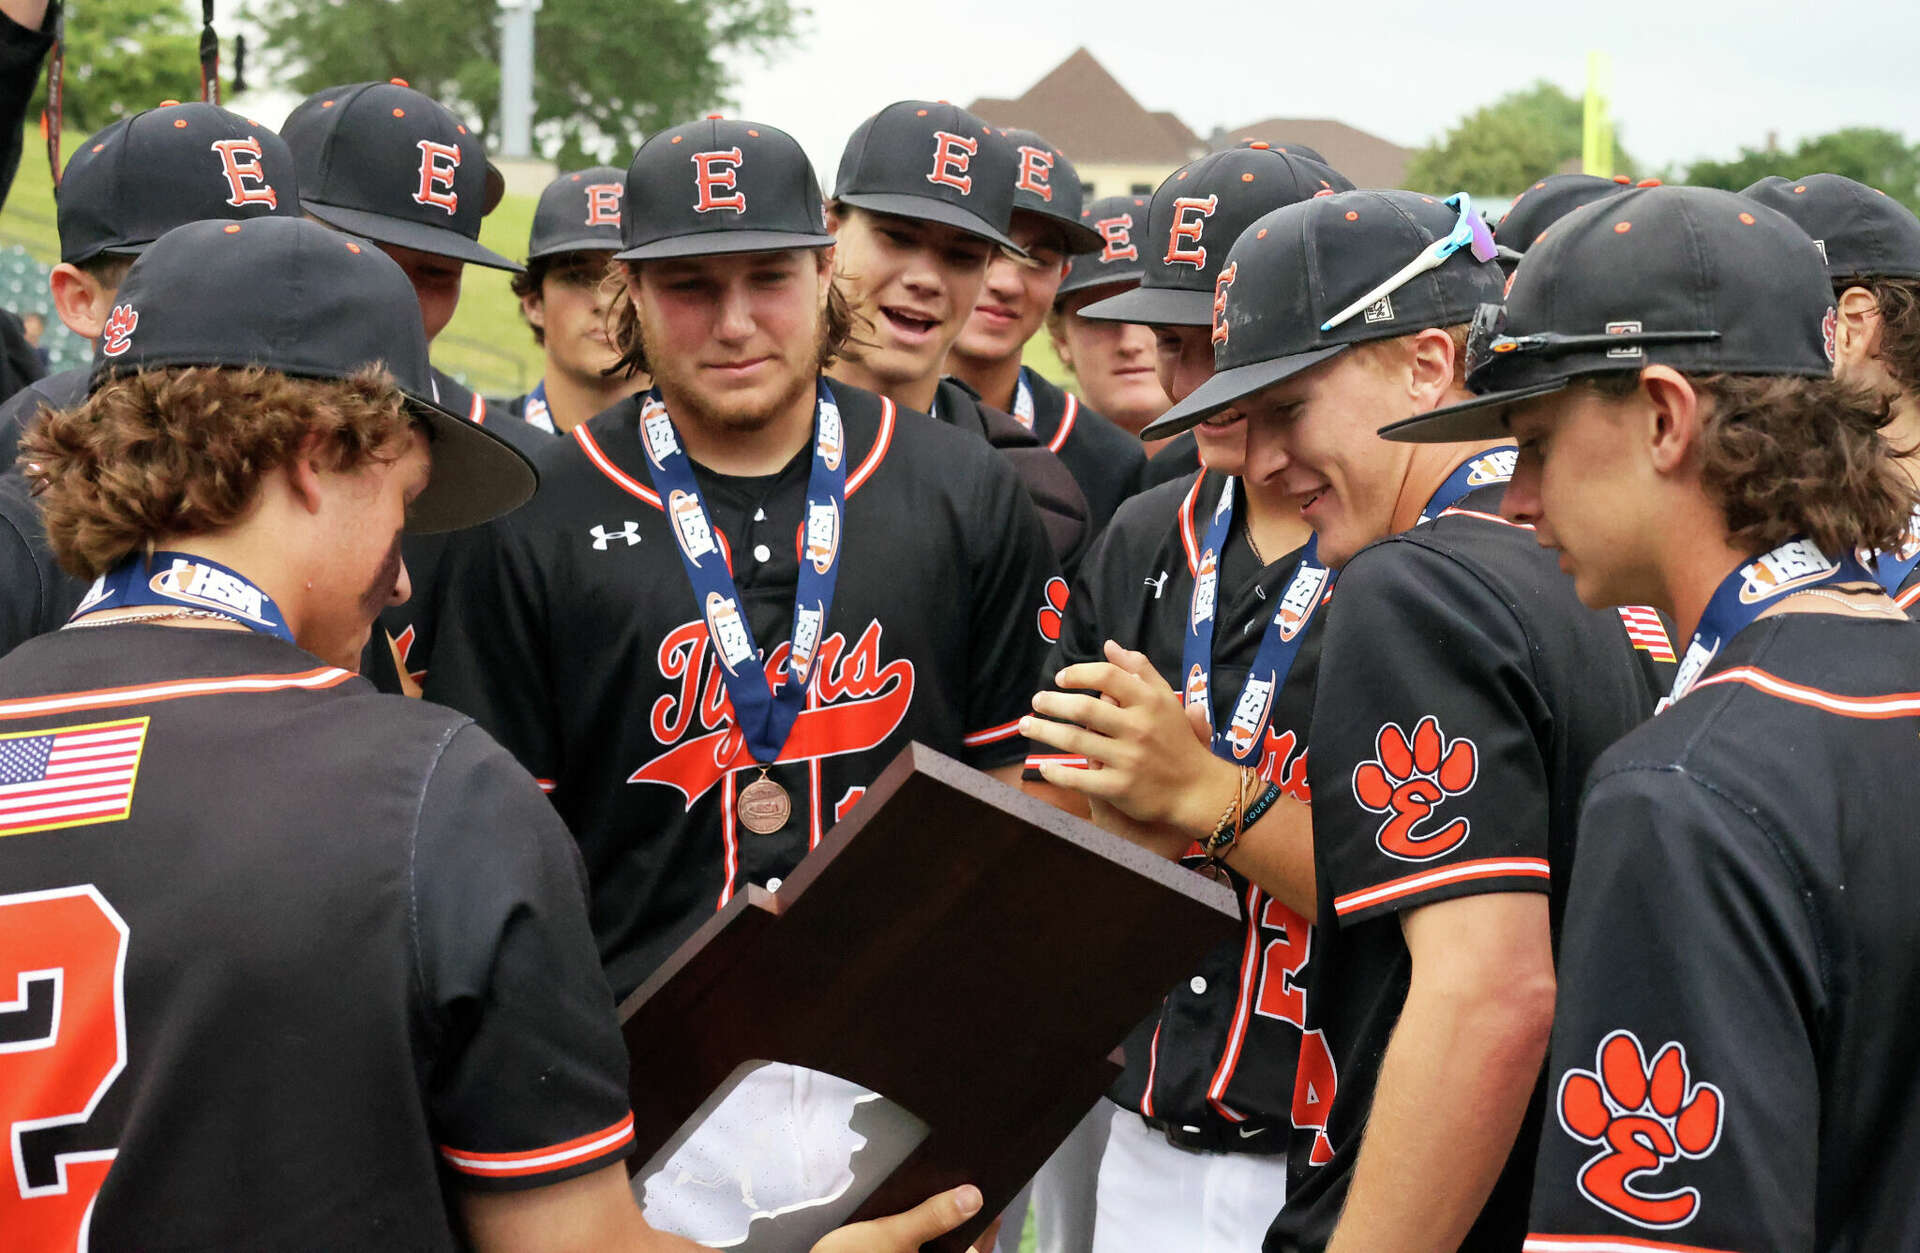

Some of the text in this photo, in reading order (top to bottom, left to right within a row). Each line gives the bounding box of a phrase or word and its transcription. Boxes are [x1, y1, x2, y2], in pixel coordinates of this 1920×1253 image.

[211, 136, 277, 210] E
[412, 139, 461, 216] E
[690, 146, 746, 214] E
[926, 131, 977, 195] E
[1016, 145, 1054, 202] E
[585, 182, 623, 227] E
[1094, 213, 1138, 263] E
[1163, 195, 1218, 271] E
[1254, 897, 1313, 1030] 2
